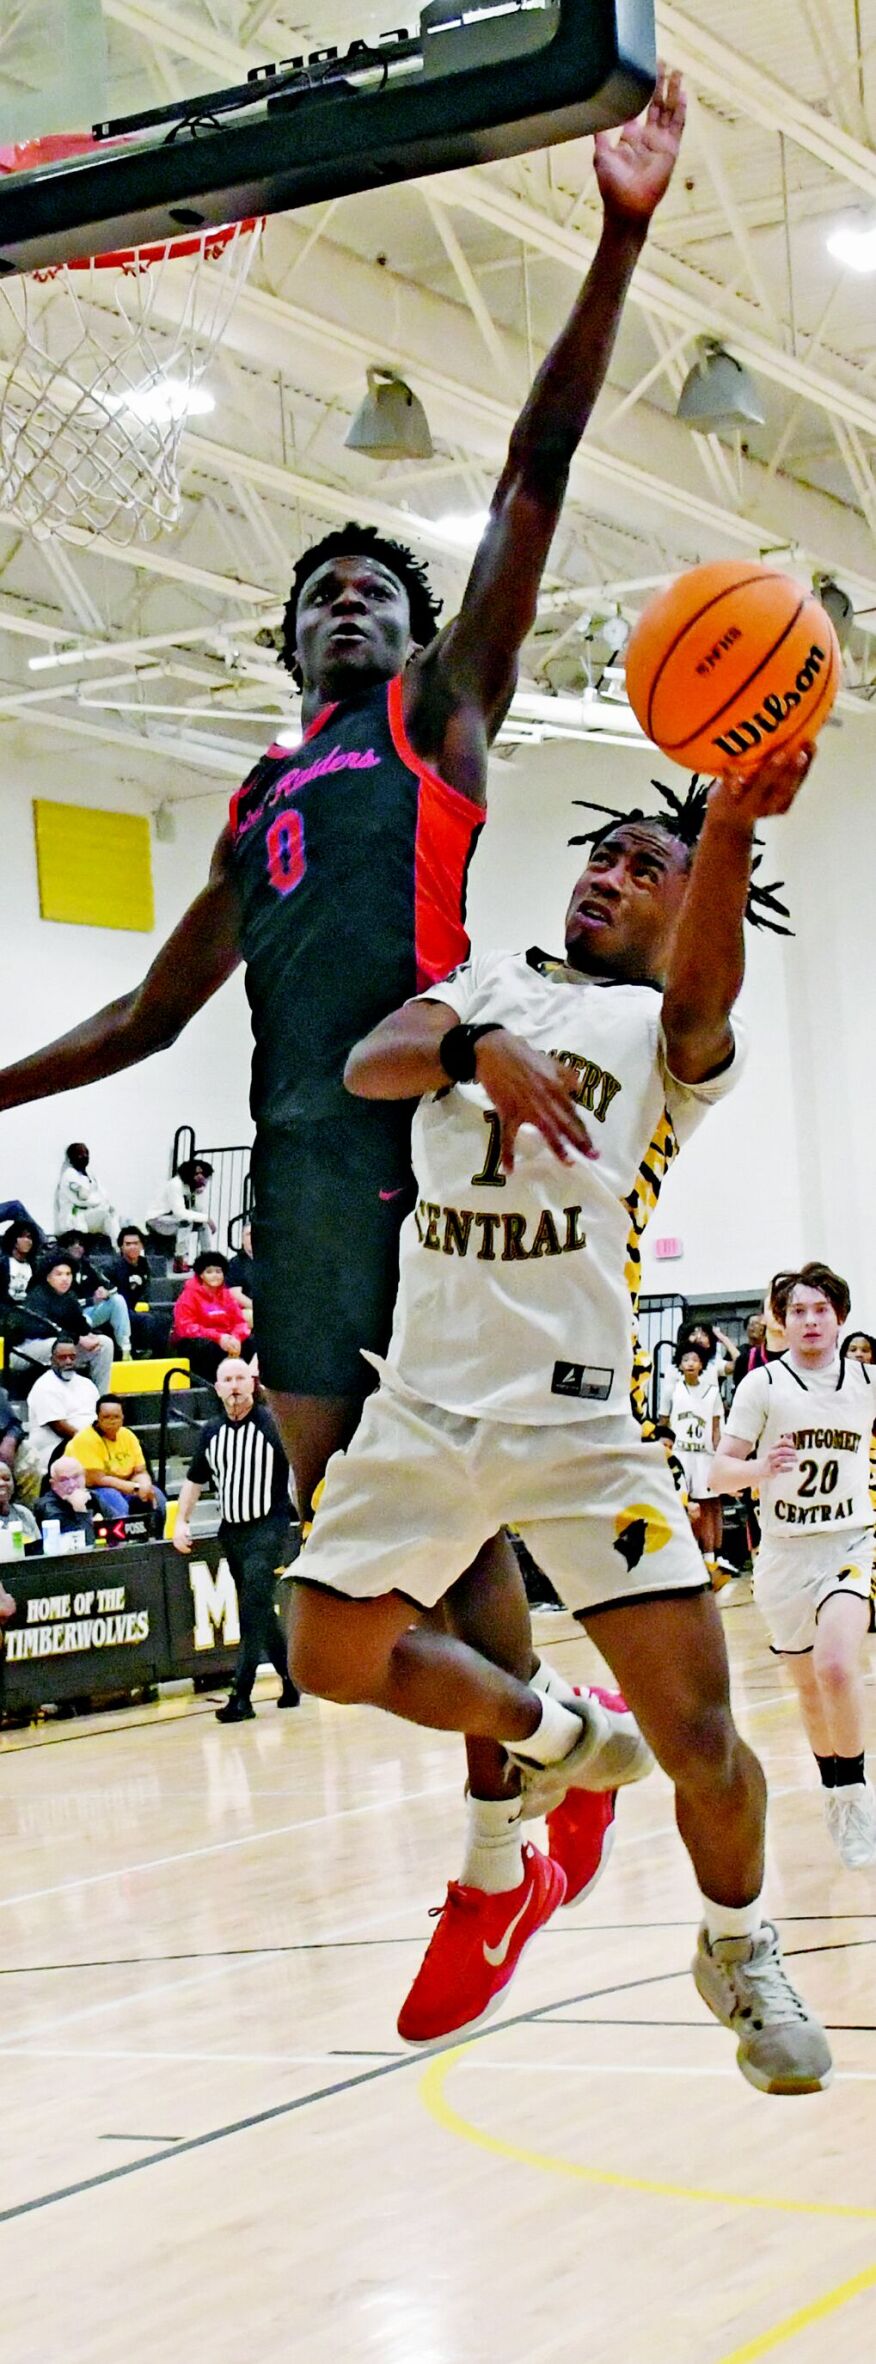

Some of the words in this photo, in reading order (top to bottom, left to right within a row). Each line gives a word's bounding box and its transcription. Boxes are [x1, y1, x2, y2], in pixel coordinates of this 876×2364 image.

[714, 645, 825, 757] Wilson
[266, 809, 308, 897] 0
[797, 1460, 839, 1497] 20
[4, 1610, 149, 1663] TIMBERWOLVES
[27, 1594, 71, 1624] HOME
[74, 1590, 94, 1617] OF
[97, 1586, 125, 1613] THE
[189, 1557, 241, 1651] M
